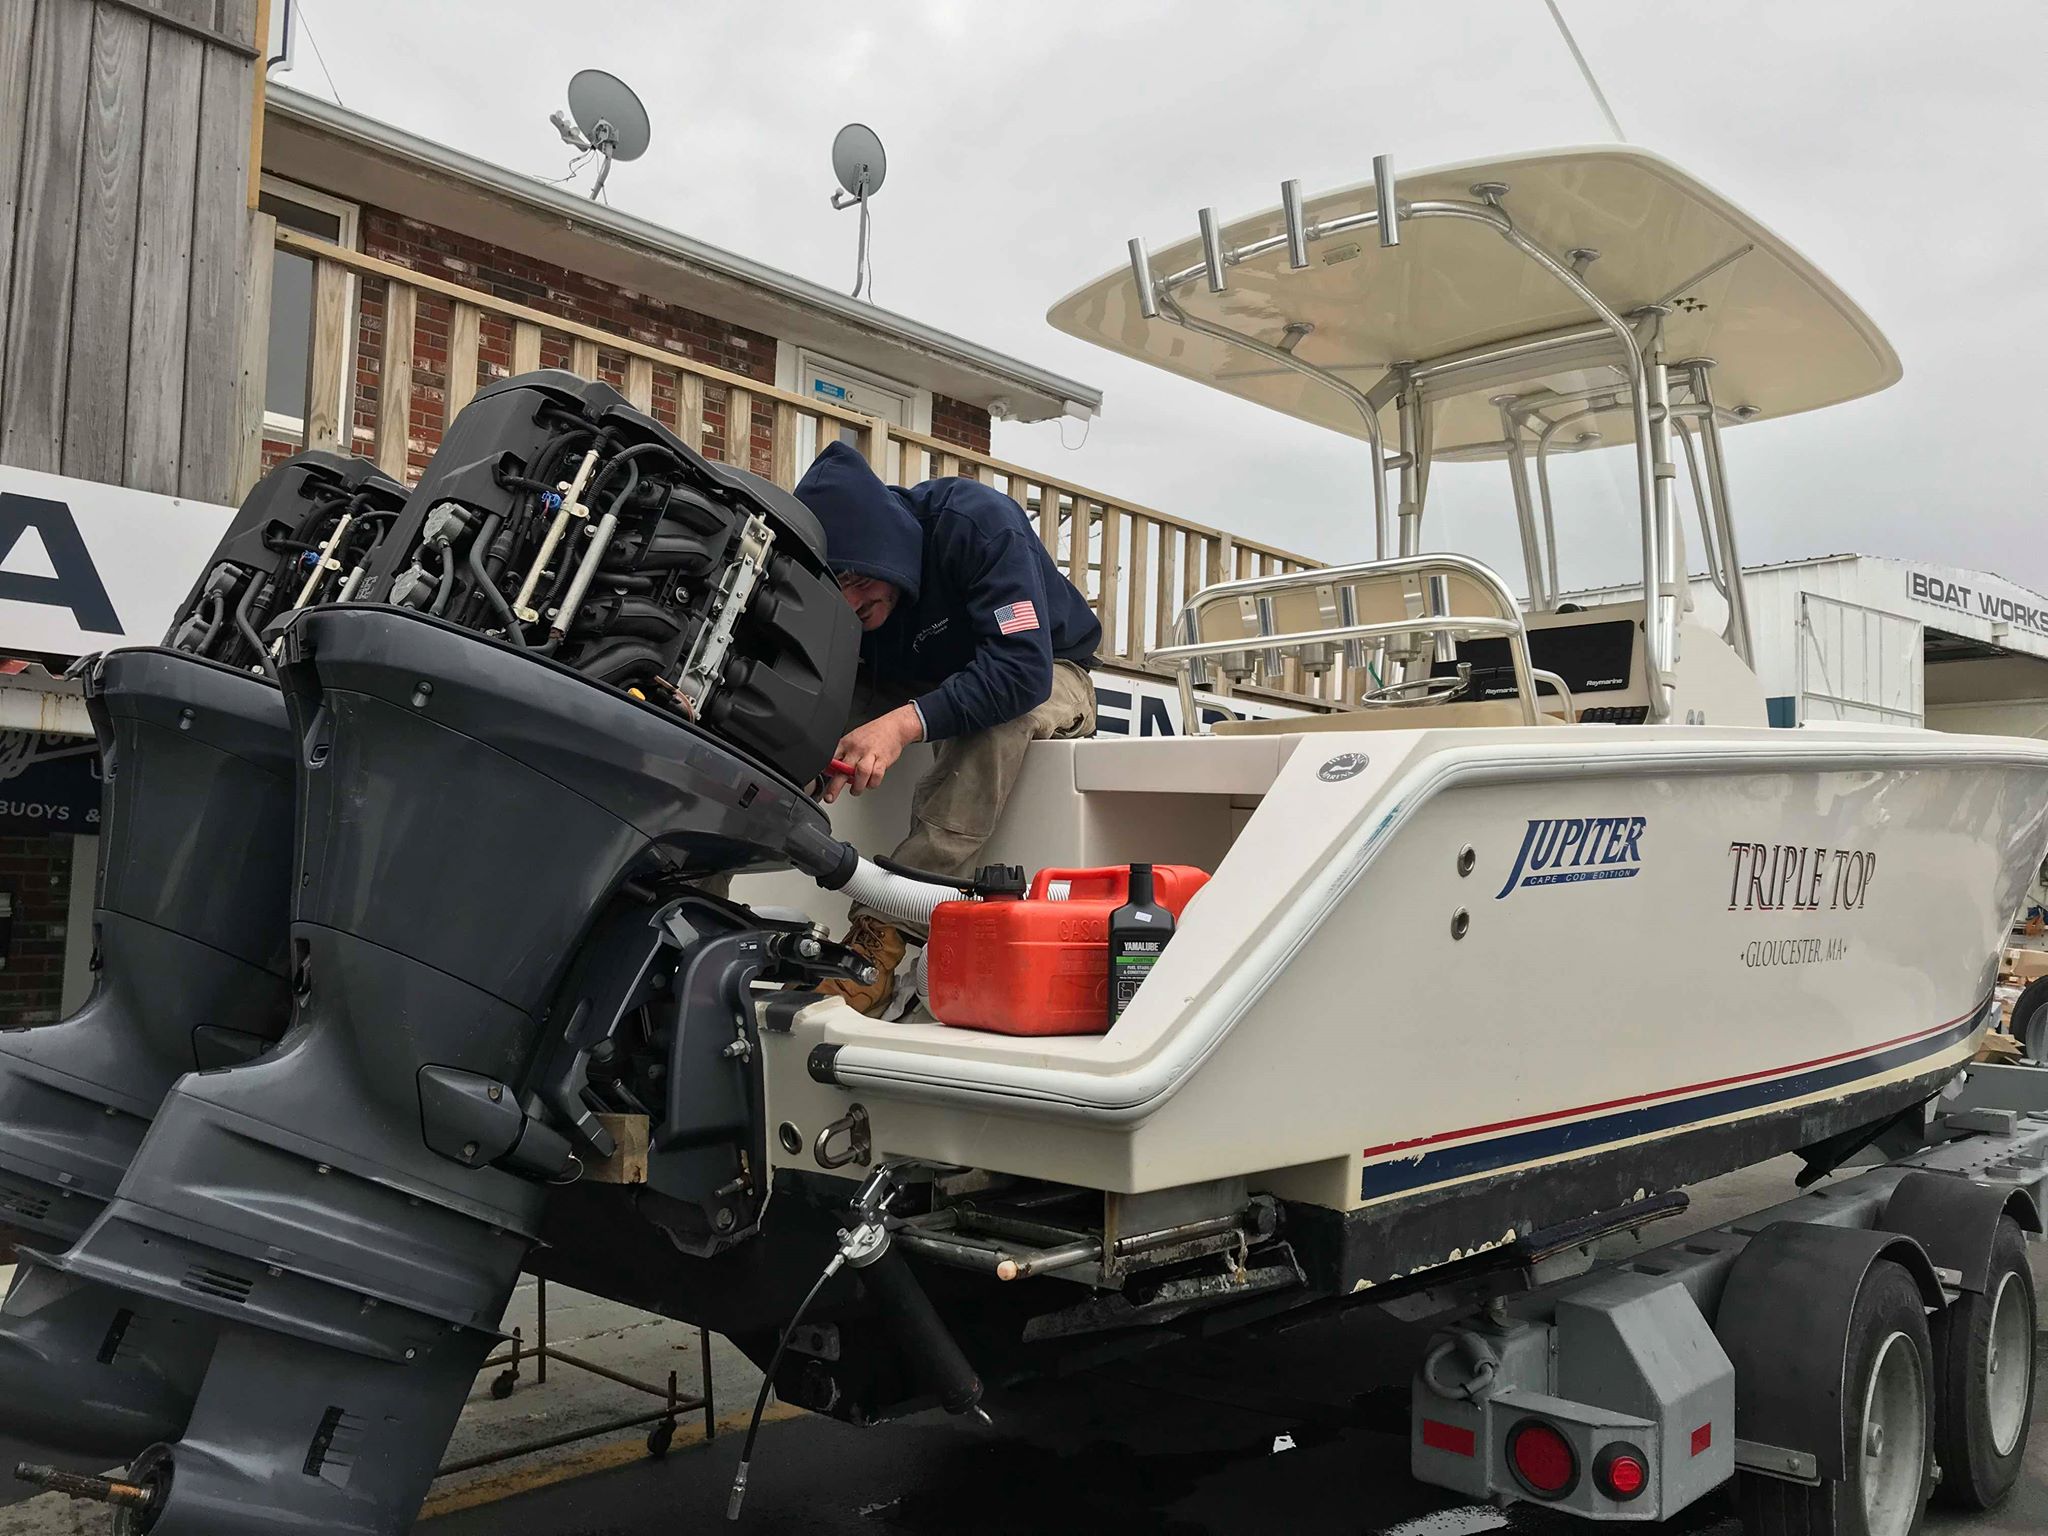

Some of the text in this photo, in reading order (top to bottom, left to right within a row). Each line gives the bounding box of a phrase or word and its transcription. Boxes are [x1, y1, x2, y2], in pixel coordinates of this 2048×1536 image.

[1913, 572, 2048, 632] BOAT WORKS
[1585, 678, 1624, 687] Raymarine
[0, 799, 70, 821] BUOYS
[1494, 816, 1647, 900] JUPITER
[1530, 869, 1631, 885] CAPE COD EDITION
[1728, 841, 1876, 911] TRIPLE TOP
[1124, 941, 1159, 952] YAMALUBE
[1746, 938, 1823, 968] GLOUCESTER,
